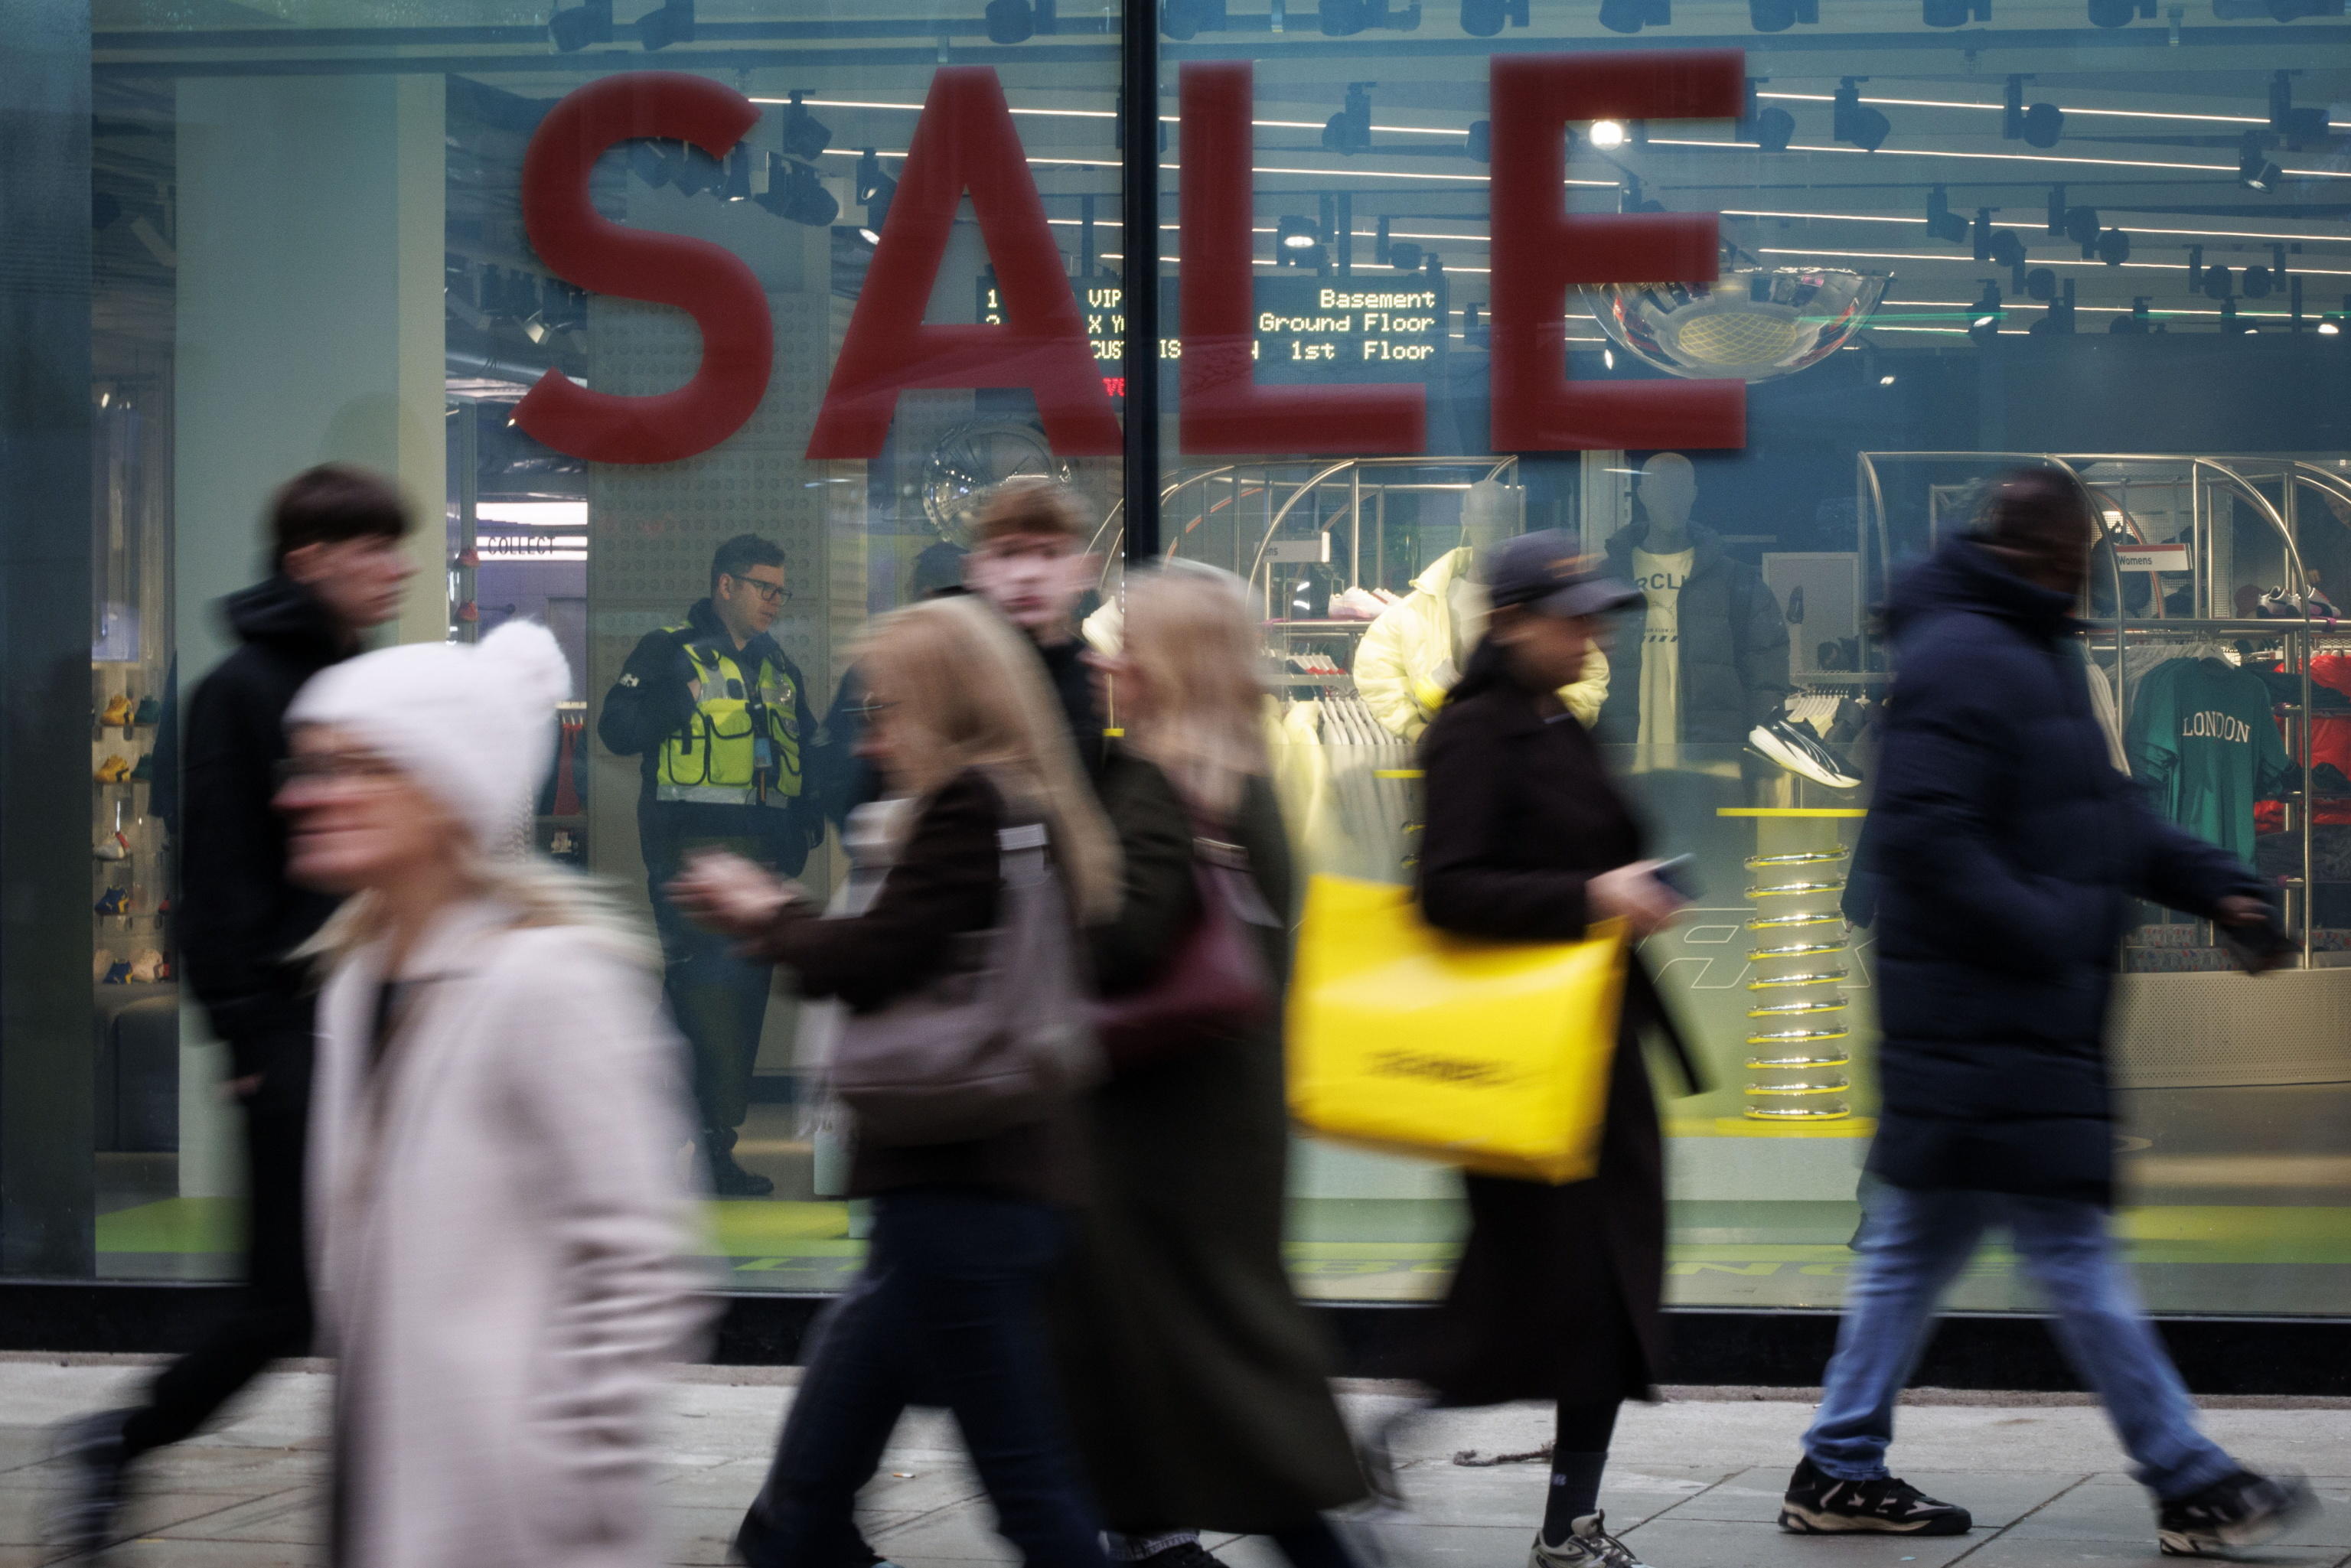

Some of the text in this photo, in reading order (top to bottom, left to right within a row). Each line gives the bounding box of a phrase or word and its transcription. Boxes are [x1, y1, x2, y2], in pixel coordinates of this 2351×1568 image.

[508, 48, 1748, 465] SALE
[1088, 288, 1123, 308] VIP
[1320, 288, 1435, 308] Basement
[1260, 312, 1351, 331] Ground
[1364, 313, 1435, 331] Floor
[1292, 341, 1435, 360] 1st Floor
[487, 536, 556, 555] COLLECT
[2118, 555, 2153, 566] Womens
